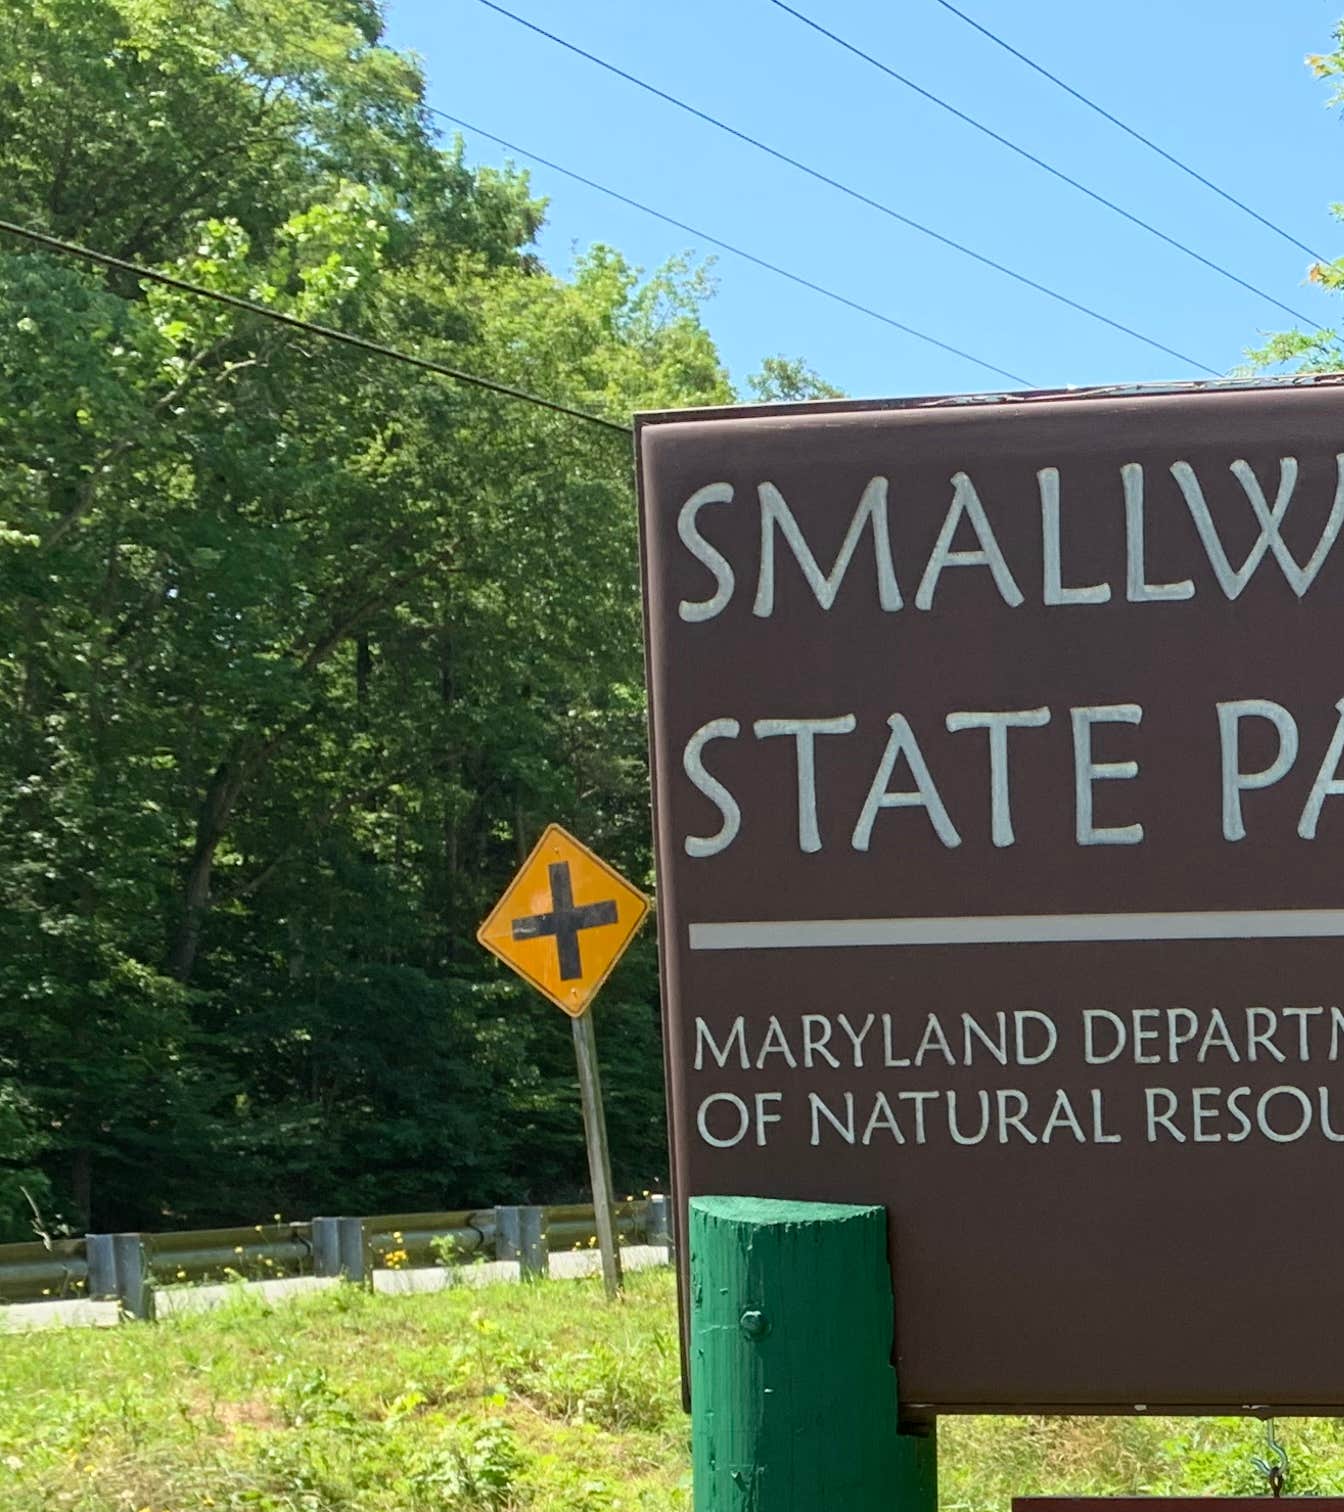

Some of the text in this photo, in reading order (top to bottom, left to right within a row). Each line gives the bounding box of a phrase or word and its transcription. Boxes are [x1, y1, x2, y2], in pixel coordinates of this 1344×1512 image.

[683, 703, 1145, 858] STATE
[694, 1010, 1058, 1070] MARYLAND
[697, 1092, 783, 1148] OF
[808, 1088, 1123, 1146] NATURAL
